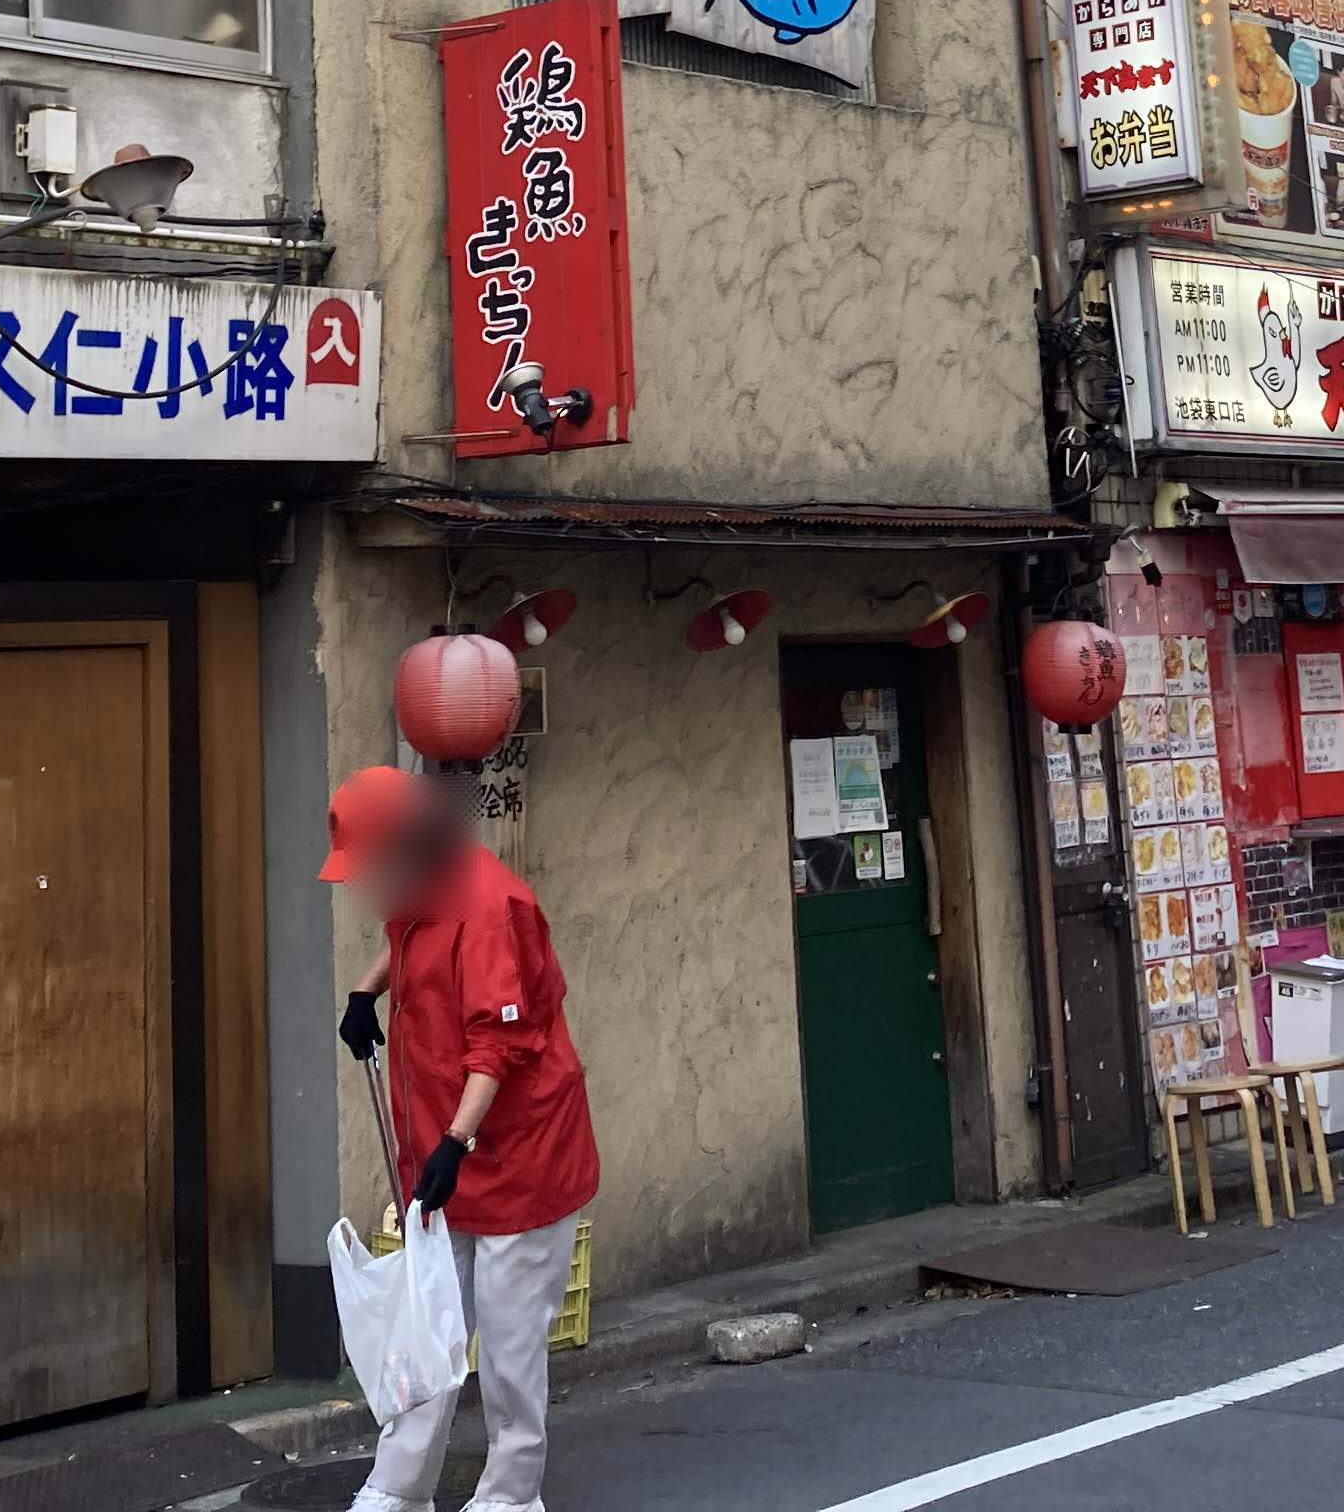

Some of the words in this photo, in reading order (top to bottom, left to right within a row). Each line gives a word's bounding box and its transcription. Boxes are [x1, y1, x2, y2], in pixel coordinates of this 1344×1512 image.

[1089, 18, 1154, 51] 専門店
[1079, 58, 1175, 100] 天下鳥ます
[497, 41, 585, 241] 鶏魚
[1090, 104, 1179, 170] お弁当
[1170, 280, 1225, 307] 営業時間
[311, 317, 356, 366] 入
[1175, 396, 1246, 423] 池袋東口店
